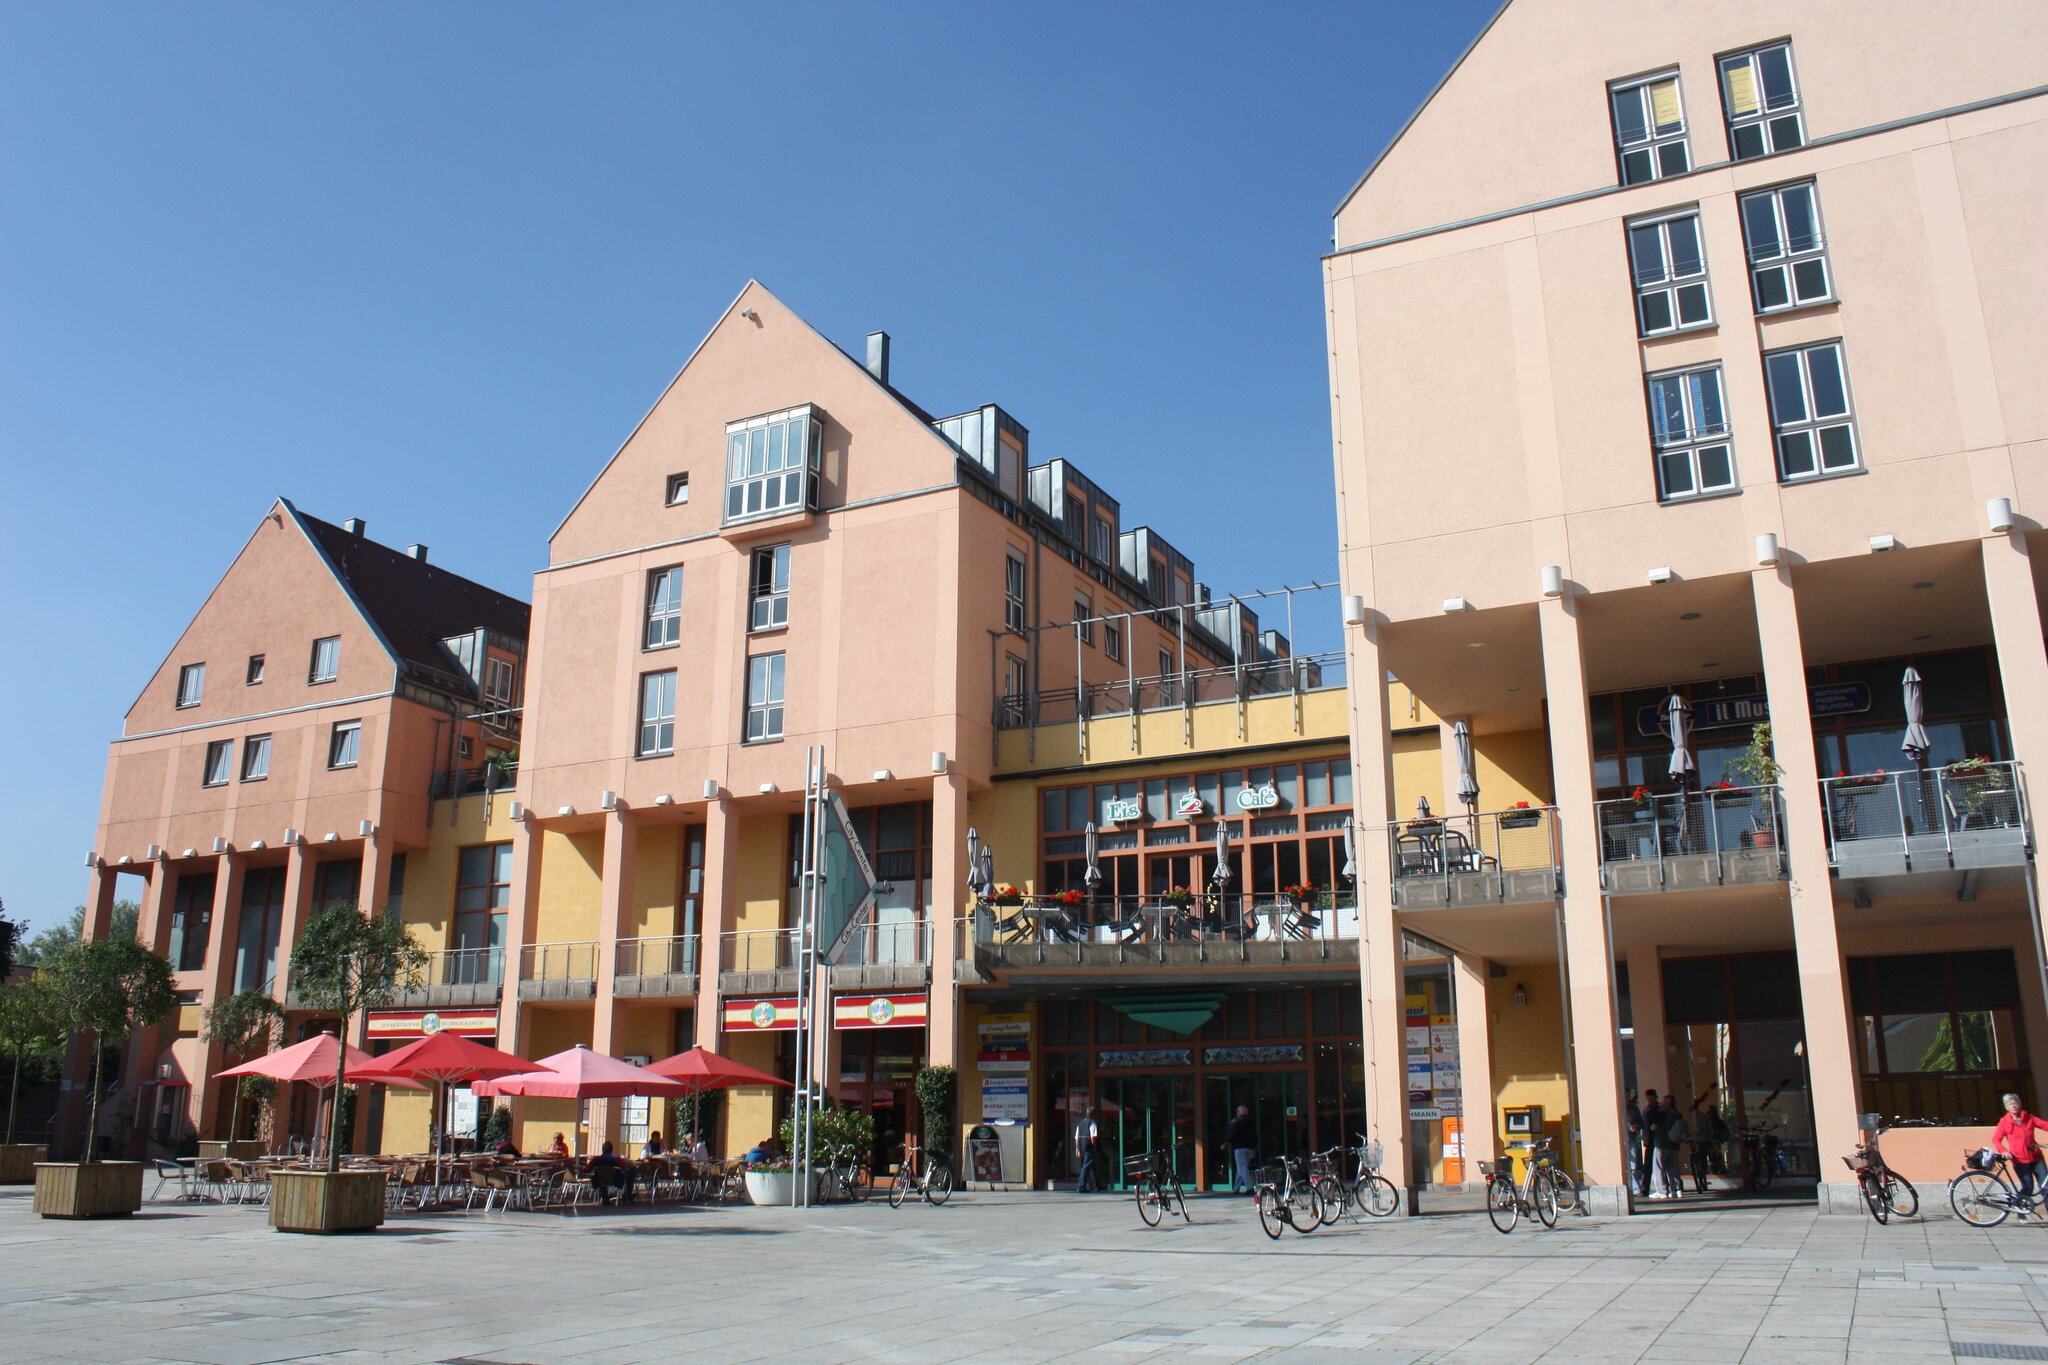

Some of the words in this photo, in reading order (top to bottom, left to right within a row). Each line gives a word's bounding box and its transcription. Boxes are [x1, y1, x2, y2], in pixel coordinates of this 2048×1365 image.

[1814, 687, 1857, 696] RISTORANTE
[1815, 695, 1846, 704] PIZZERIA
[1716, 703, 1729, 721] il
[1816, 702, 1854, 711] GELATERIA
[1109, 803, 1139, 820] Eis
[1239, 788, 1277, 808] Café
[845, 820, 870, 874] City-Center
[840, 903, 870, 944] City-Center
